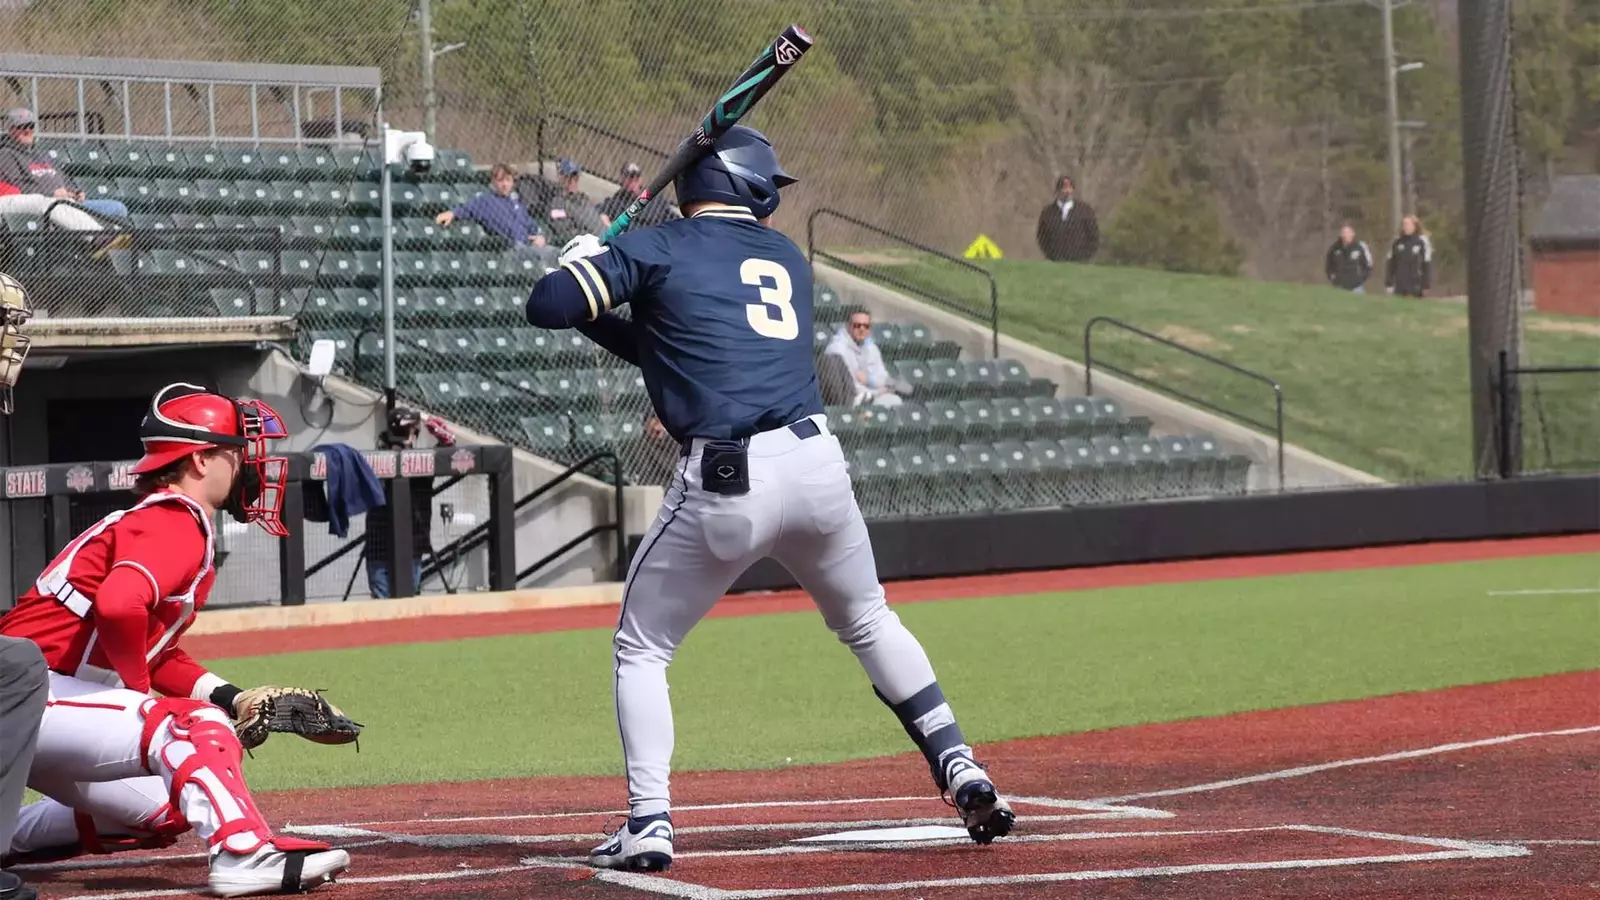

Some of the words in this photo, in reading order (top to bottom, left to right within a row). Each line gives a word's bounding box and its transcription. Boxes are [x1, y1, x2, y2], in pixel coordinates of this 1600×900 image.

[779, 40, 798, 62] LS
[740, 258, 799, 340] 3
[402, 452, 434, 475] STATE
[7, 470, 46, 495] STATE
